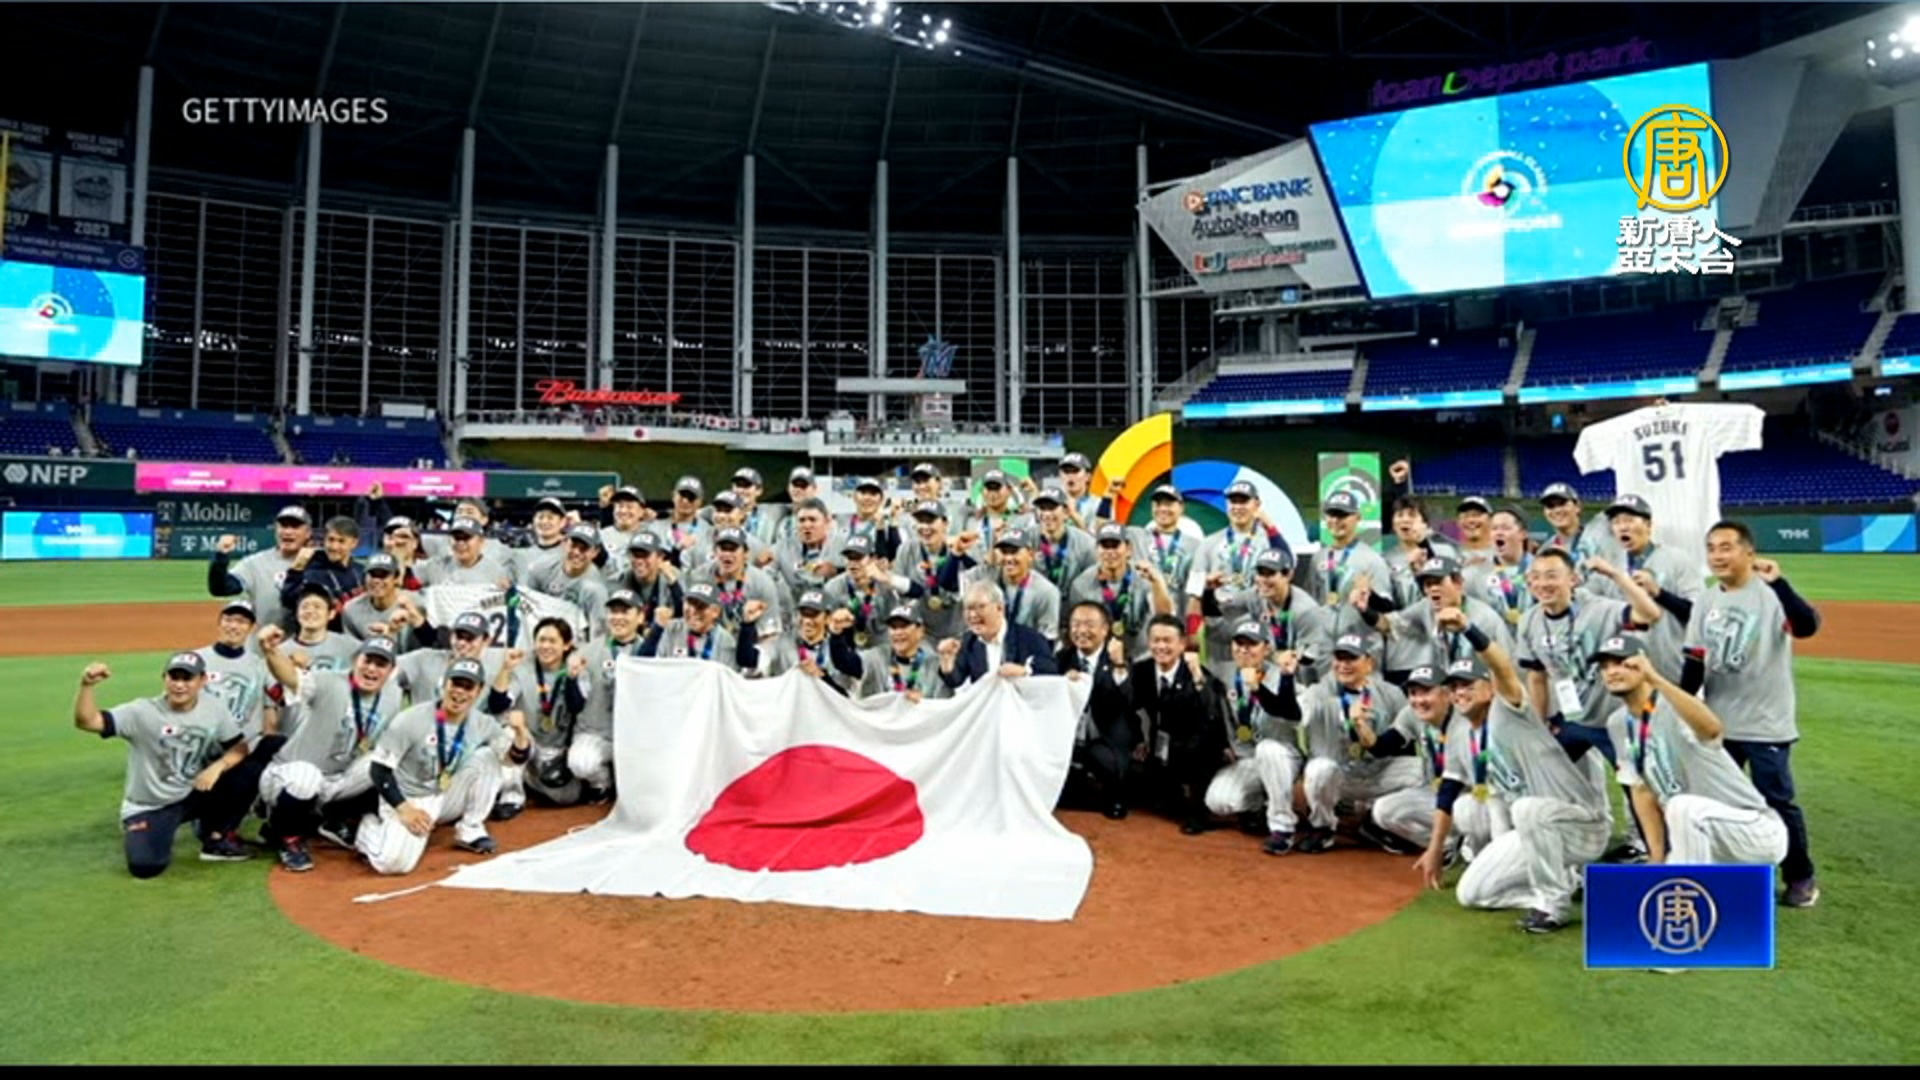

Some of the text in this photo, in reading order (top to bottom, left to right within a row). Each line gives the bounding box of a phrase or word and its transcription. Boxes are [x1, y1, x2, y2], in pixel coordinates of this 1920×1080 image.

[1564, 36, 1655, 82] park
[1192, 209, 1298, 237] AutoNation
[1633, 420, 1688, 442] SUZUKI
[31, 464, 88, 484] NFP
[1642, 441, 1686, 483] 51
[180, 501, 252, 523] Mobile
